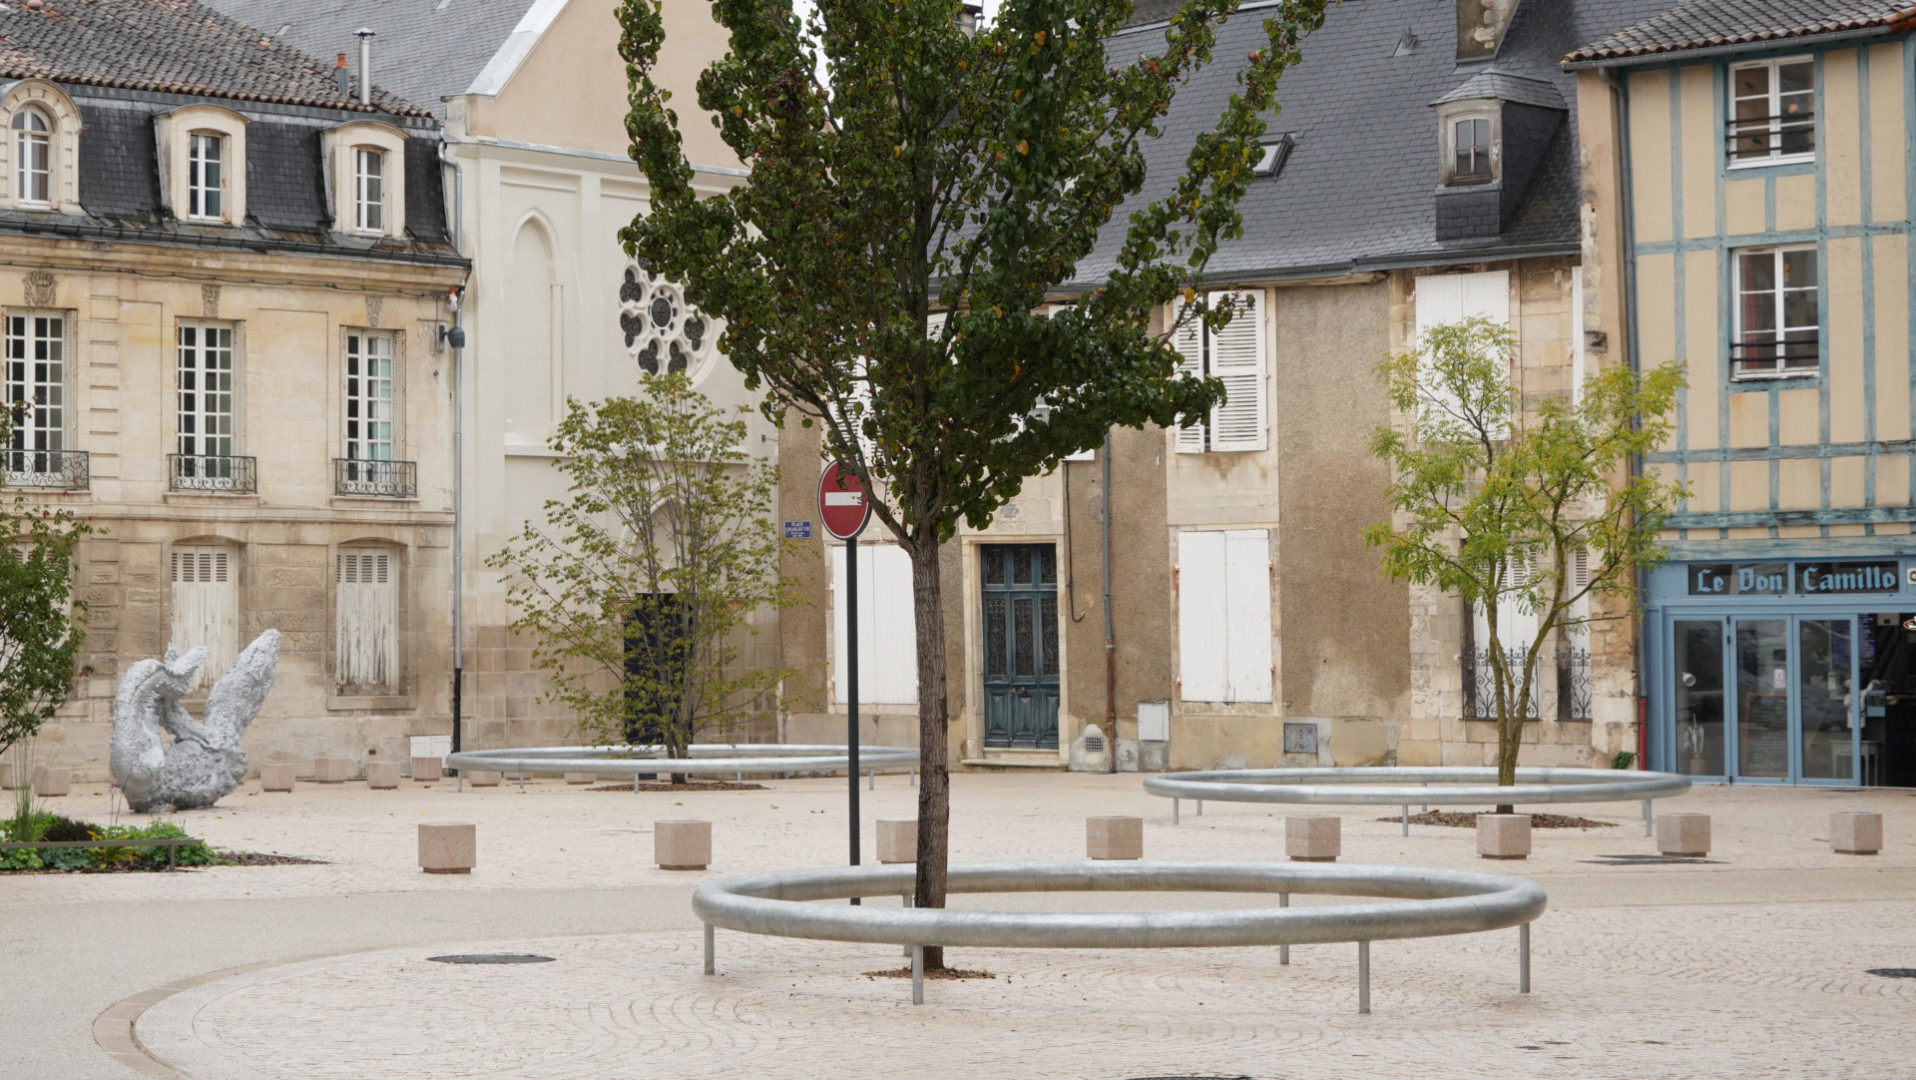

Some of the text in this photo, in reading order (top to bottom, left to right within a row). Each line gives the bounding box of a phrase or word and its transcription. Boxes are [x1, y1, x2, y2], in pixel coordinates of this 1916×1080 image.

[1697, 569, 1724, 592] Le
[1739, 568, 1783, 591] Don
[1803, 566, 1897, 591] Camillo
